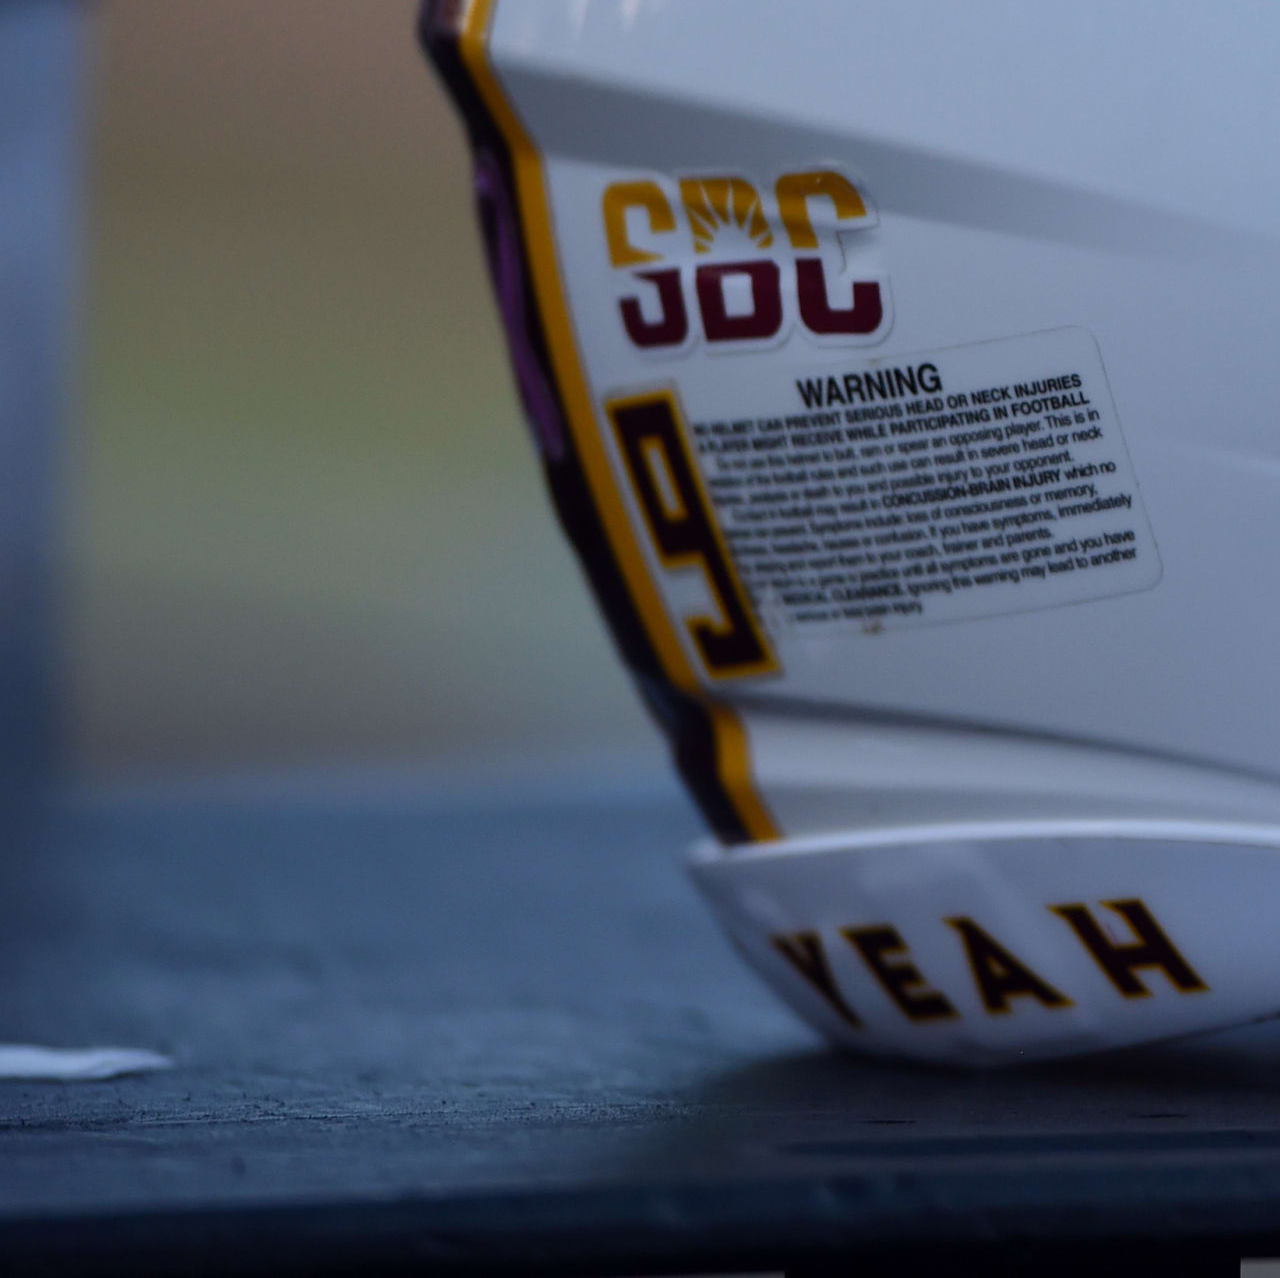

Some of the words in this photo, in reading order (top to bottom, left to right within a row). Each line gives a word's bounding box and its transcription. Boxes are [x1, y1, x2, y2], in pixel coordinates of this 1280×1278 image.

[602, 171, 883, 349] SBC
[785, 410, 842, 428] PREVENT
[844, 403, 903, 422] SERIOUS
[905, 397, 945, 414] HEAD
[946, 393, 969, 409] OR
[970, 386, 1012, 405] NECK
[1013, 374, 1082, 397] INJURIES
[796, 363, 943, 410] WARNING
[845, 423, 886, 440] WHILE
[889, 408, 991, 434] PARTICIPATING
[993, 405, 1009, 419] IN
[1010, 391, 1090, 416] FOOTBALL
[932, 436, 947, 447] an
[949, 426, 1003, 446] opposing
[1004, 421, 1044, 439] player.
[1045, 413, 1072, 429] This
[1073, 411, 1085, 424] is
[1086, 409, 1100, 421] in
[910, 456, 933, 468] can
[934, 448, 965, 465] result
[966, 447, 979, 460] in
[980, 442, 1021, 458] severe
[1021, 434, 1054, 451] head
[1056, 434, 1070, 445] or
[1071, 425, 1104, 442] neck
[936, 469, 969, 484] injury
[969, 465, 983, 477] to
[984, 462, 1011, 478] your
[1012, 449, 1075, 472] opponent.
[1012, 469, 1063, 489] INJURY
[1064, 461, 1098, 479] which
[1100, 461, 1117, 473] no
[960, 520, 991, 533] have
[1057, 494, 1134, 517] immediately
[1029, 493, 1042, 504] or
[1044, 484, 1098, 501] memory,
[604, 389, 781, 679] 9
[981, 533, 1004, 548] and
[1000, 551, 1020, 563] are
[1021, 545, 1052, 562] gone
[1053, 538, 1078, 554] and
[1079, 536, 1103, 552] you
[1103, 531, 1136, 545] have
[1020, 565, 1047, 578] may
[1046, 556, 1075, 573] lead
[1075, 555, 1090, 568] to
[1090, 547, 1139, 565] another
[773, 898, 1211, 1029] YEAH
